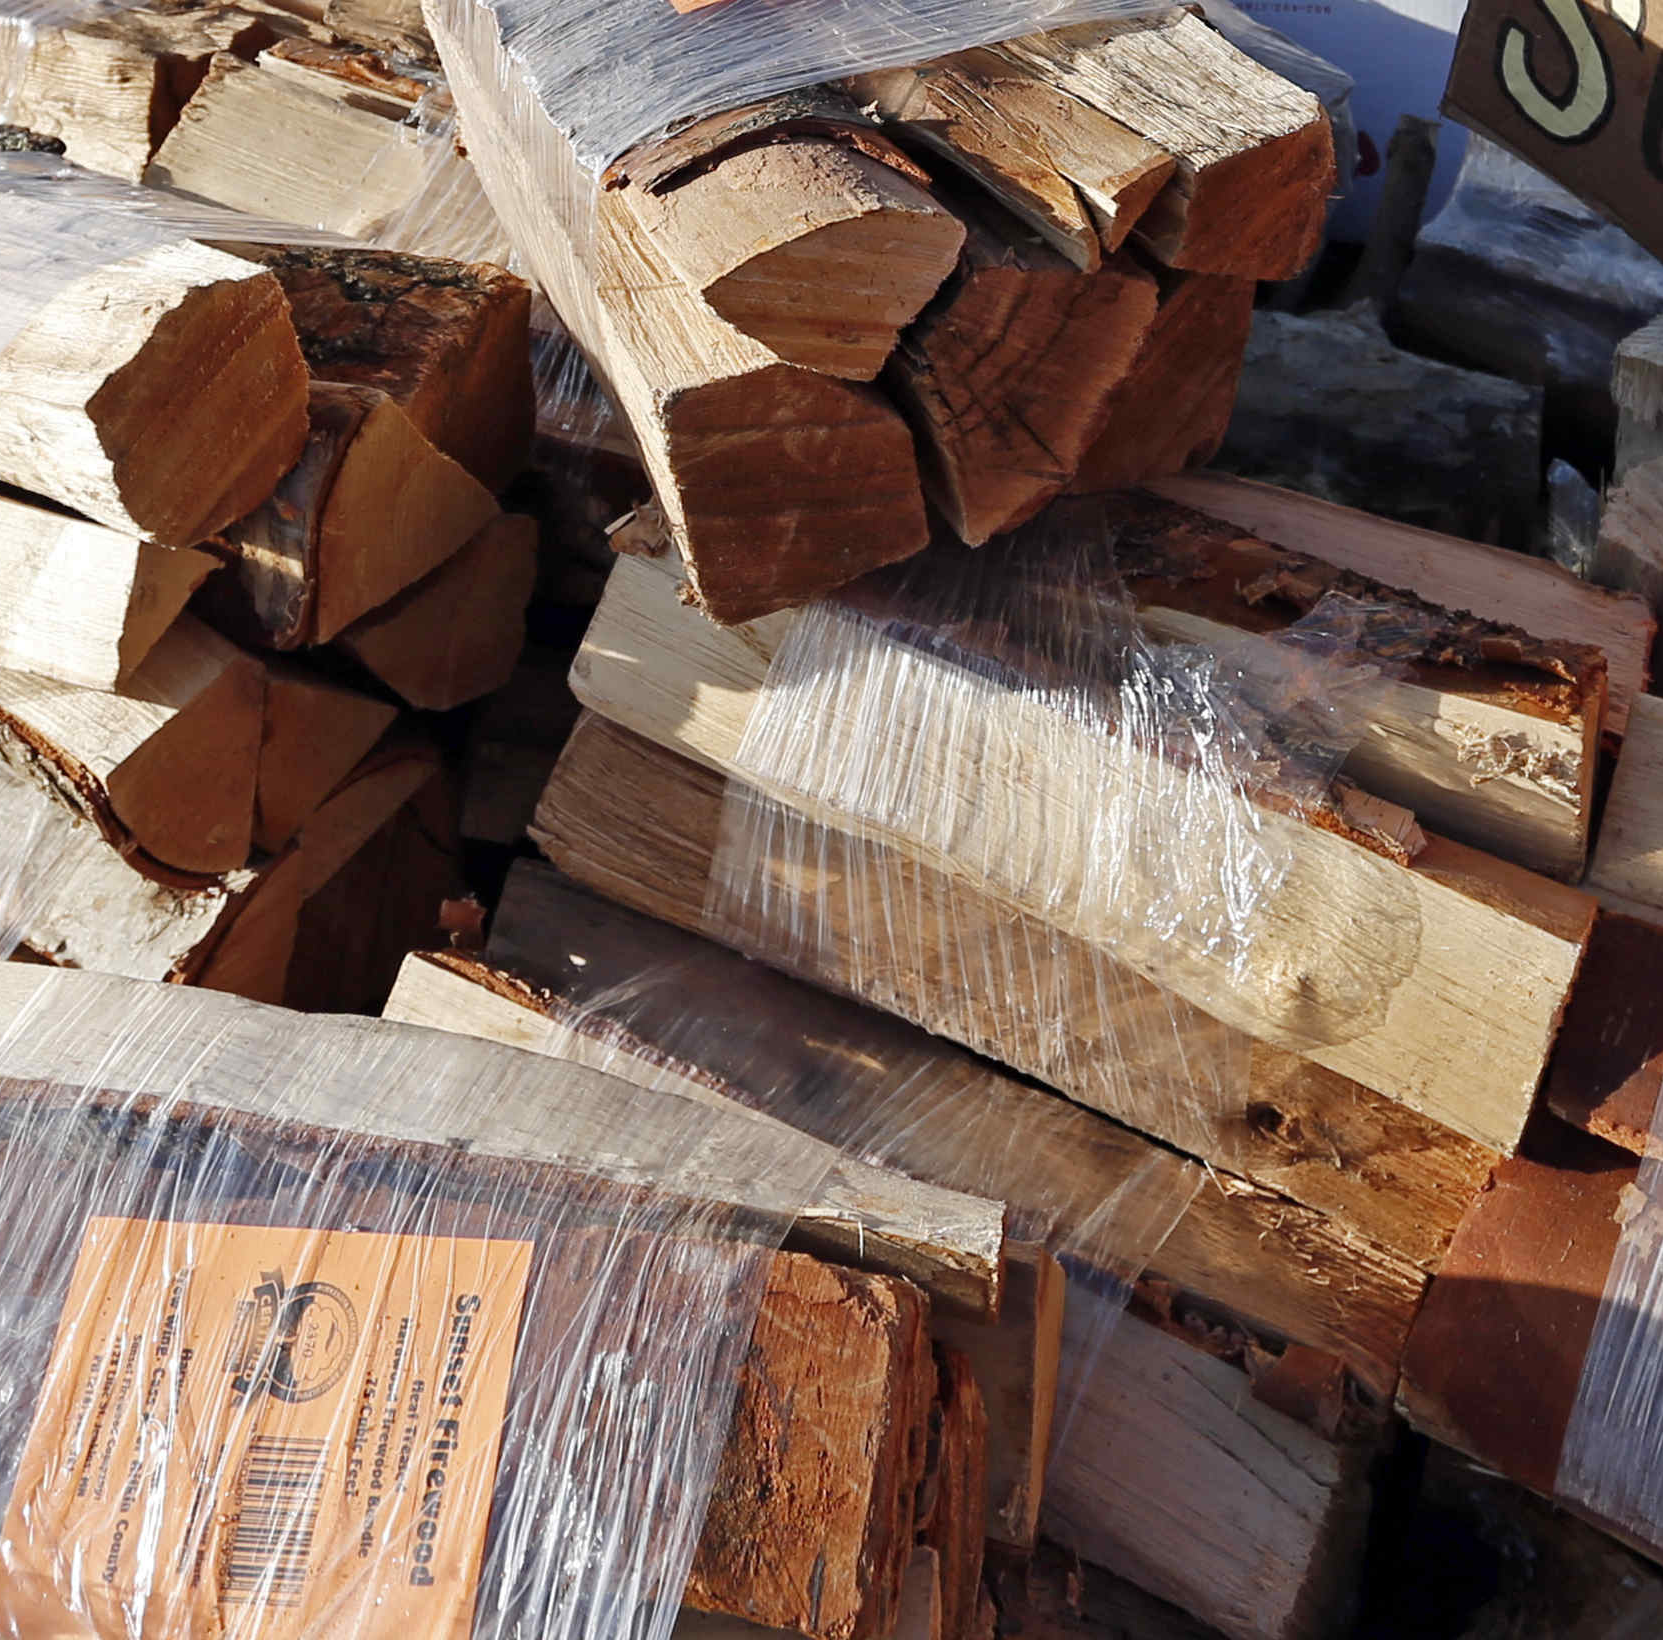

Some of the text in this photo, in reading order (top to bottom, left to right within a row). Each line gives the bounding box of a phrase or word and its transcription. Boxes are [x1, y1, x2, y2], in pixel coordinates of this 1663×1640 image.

[146, 1368, 165, 1405] Cass
[408, 1380, 425, 1420] Heat
[345, 1371, 377, 1497] .75 Cubic Feet
[371, 1409, 397, 1490] Firewood
[409, 1294, 481, 1588] Sunset Firewood
[103, 1520, 129, 1583] County
